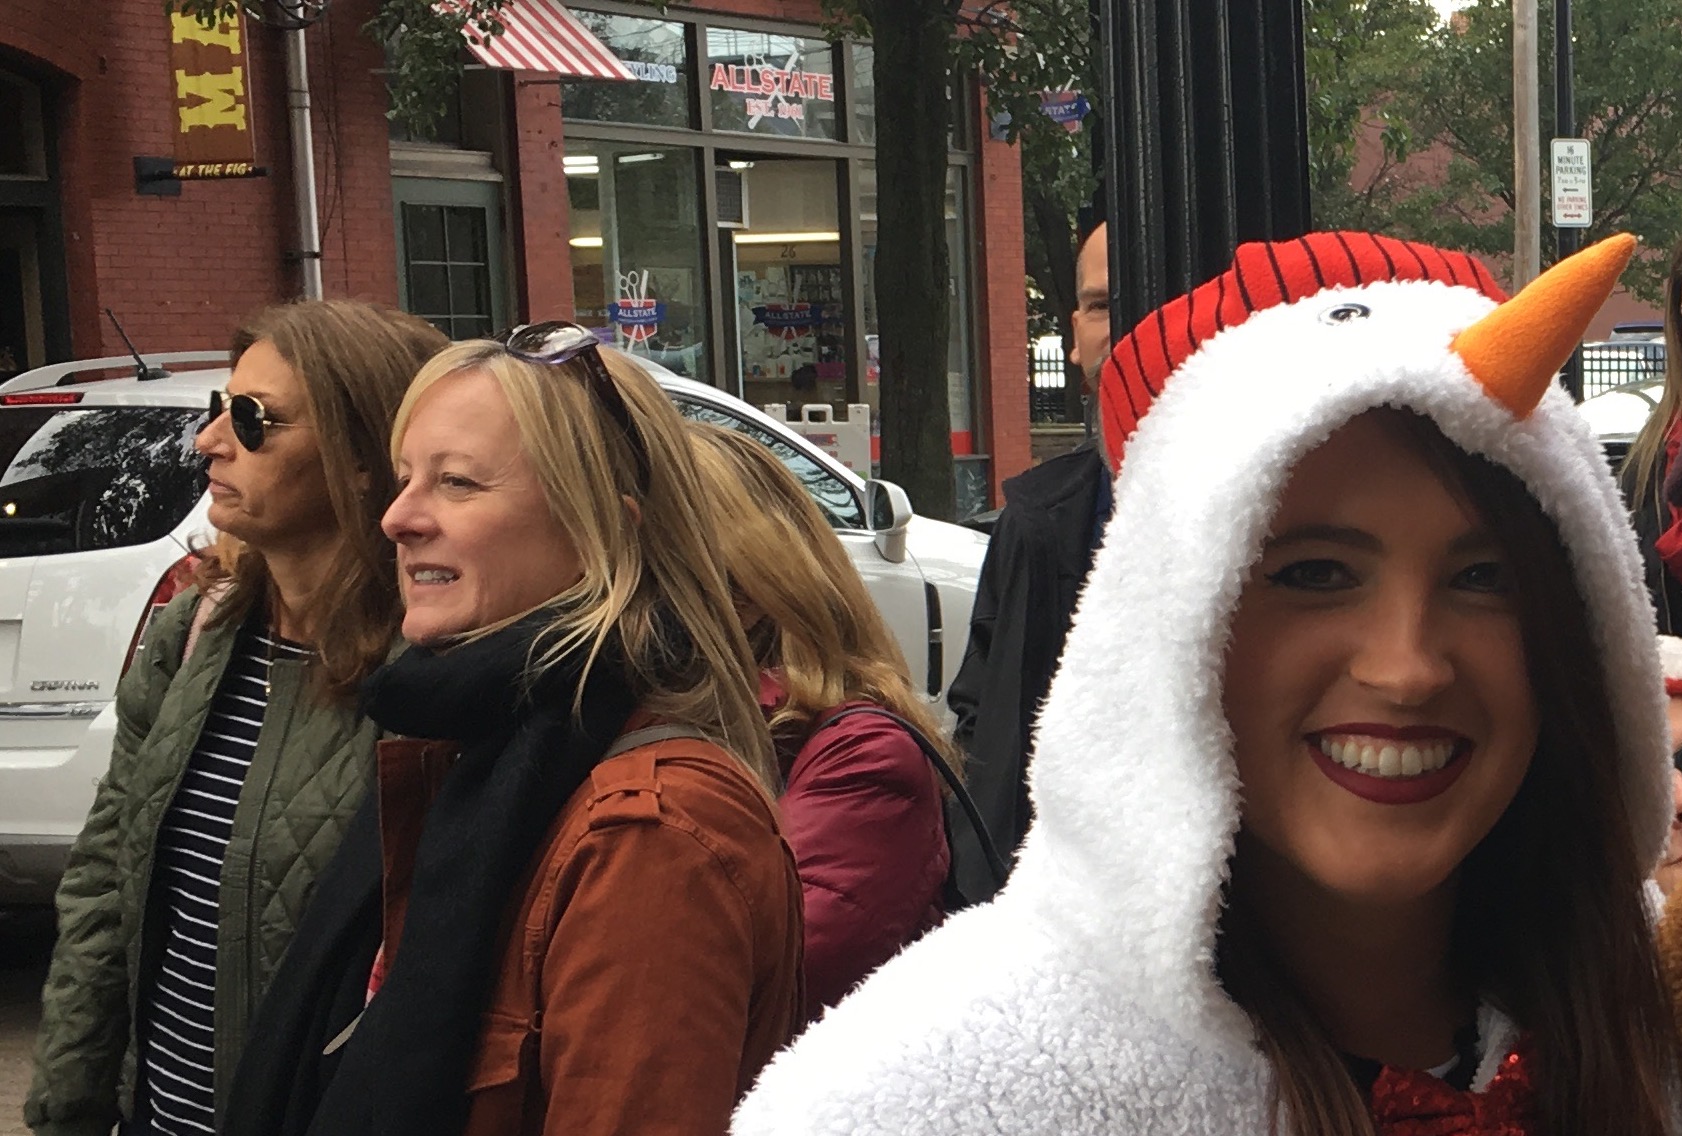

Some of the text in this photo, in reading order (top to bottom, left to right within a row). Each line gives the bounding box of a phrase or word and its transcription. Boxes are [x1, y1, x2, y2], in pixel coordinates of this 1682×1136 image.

[710, 63, 834, 101] ALLSTATE
[1557, 155, 1584, 165] MINUTE
[178, 165, 195, 178] AT
[198, 163, 223, 177] THE
[1556, 166, 1586, 176] PARKING
[781, 244, 796, 259] 26
[617, 307, 657, 318] ALLSTATE
[765, 310, 812, 320] ALLSTATE
